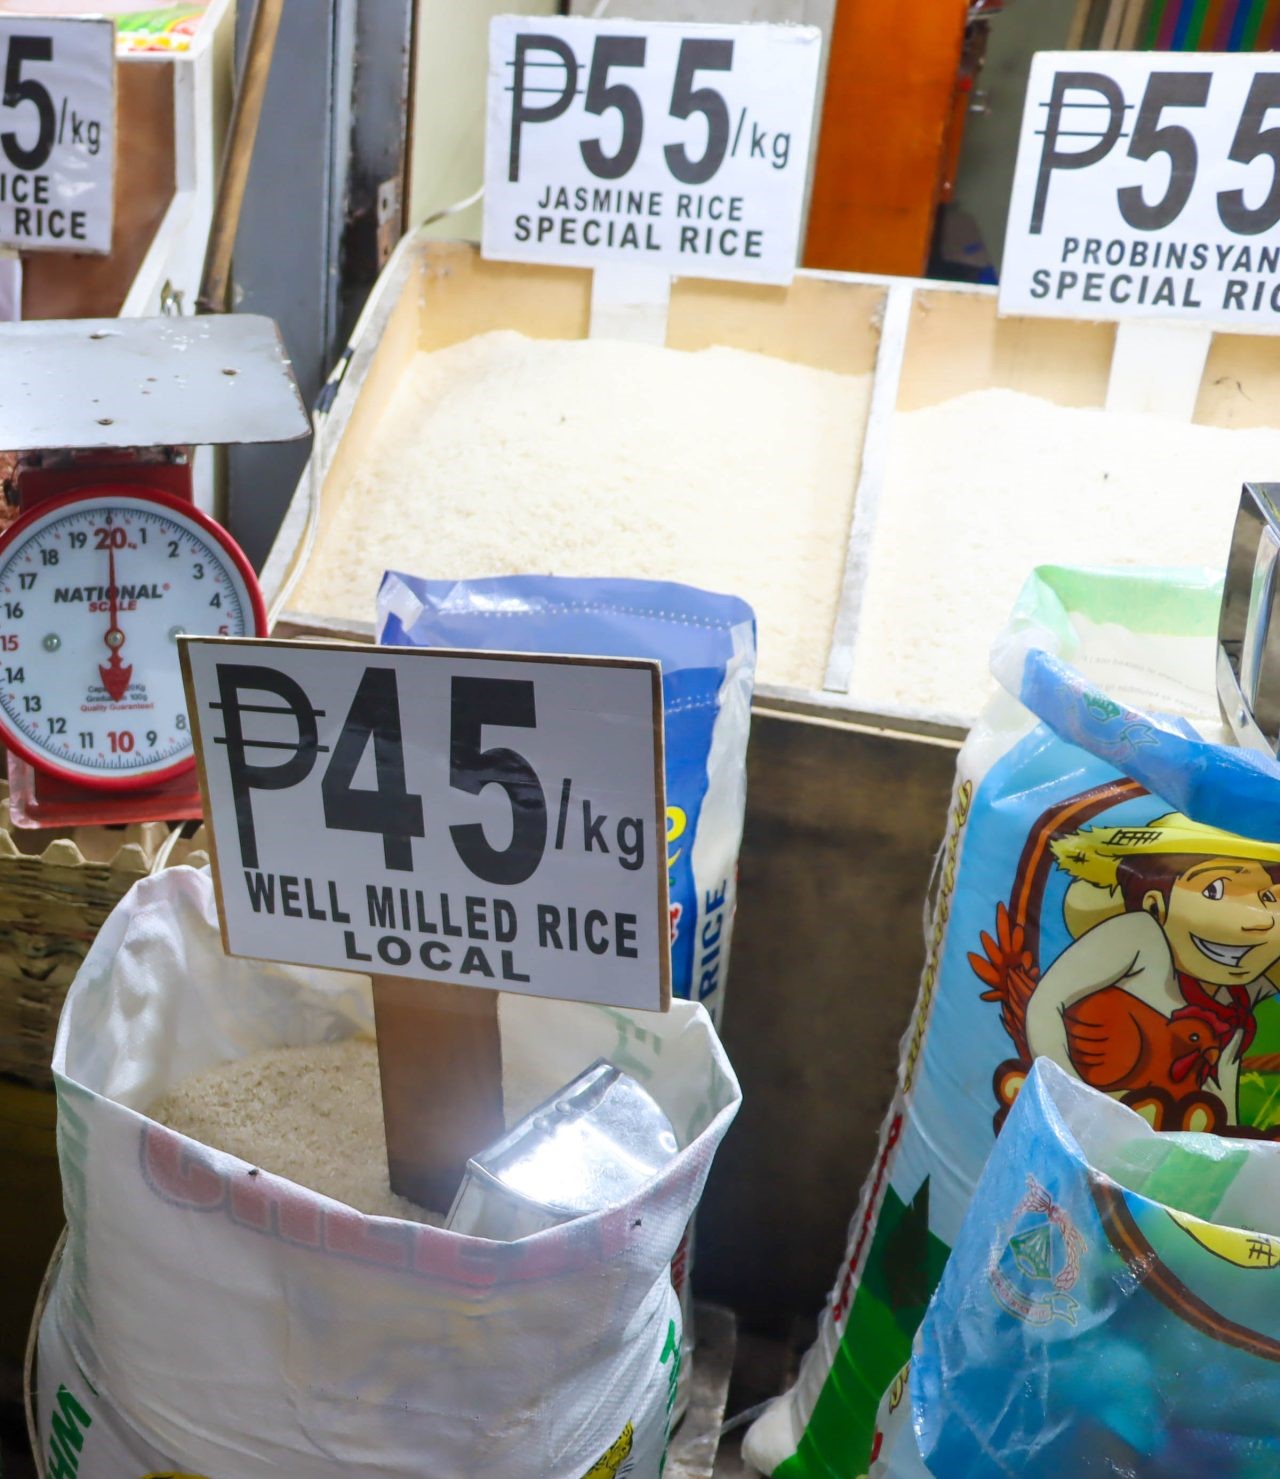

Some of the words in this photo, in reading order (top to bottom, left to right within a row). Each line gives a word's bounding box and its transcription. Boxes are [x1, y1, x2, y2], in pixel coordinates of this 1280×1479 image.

[537, 185, 663, 217] JASMINE
[677, 193, 744, 222] RICE
[14, 207, 87, 240] RICE
[514, 215, 662, 252] SPECIAL
[679, 226, 764, 259] RICE
[1029, 269, 1202, 310] SPECIAL
[68, 532, 88, 549] 19
[94, 527, 127, 550] 20
[140, 528, 147, 545] 1
[40, 549, 59, 566] 18
[168, 541, 179, 558] 2
[193, 564, 204, 580] 3
[19, 573, 38, 590] 17
[54, 584, 163, 603] NATIONAL
[210, 593, 221, 608] 4
[4, 602, 24, 619] 16
[0, 635, 19, 651] 15
[6, 667, 24, 683] 14
[23, 696, 42, 712] 13
[47, 717, 66, 734] 12
[175, 714, 187, 730] 8
[79, 731, 94, 749] 11
[107, 731, 135, 752] 10
[146, 731, 157, 747] 9
[244, 870, 351, 924] WELL
[366, 885, 518, 943] MILLED
[537, 905, 639, 959] RICE
[699, 879, 727, 1000] RICE
[344, 931, 531, 983] LOCAL
